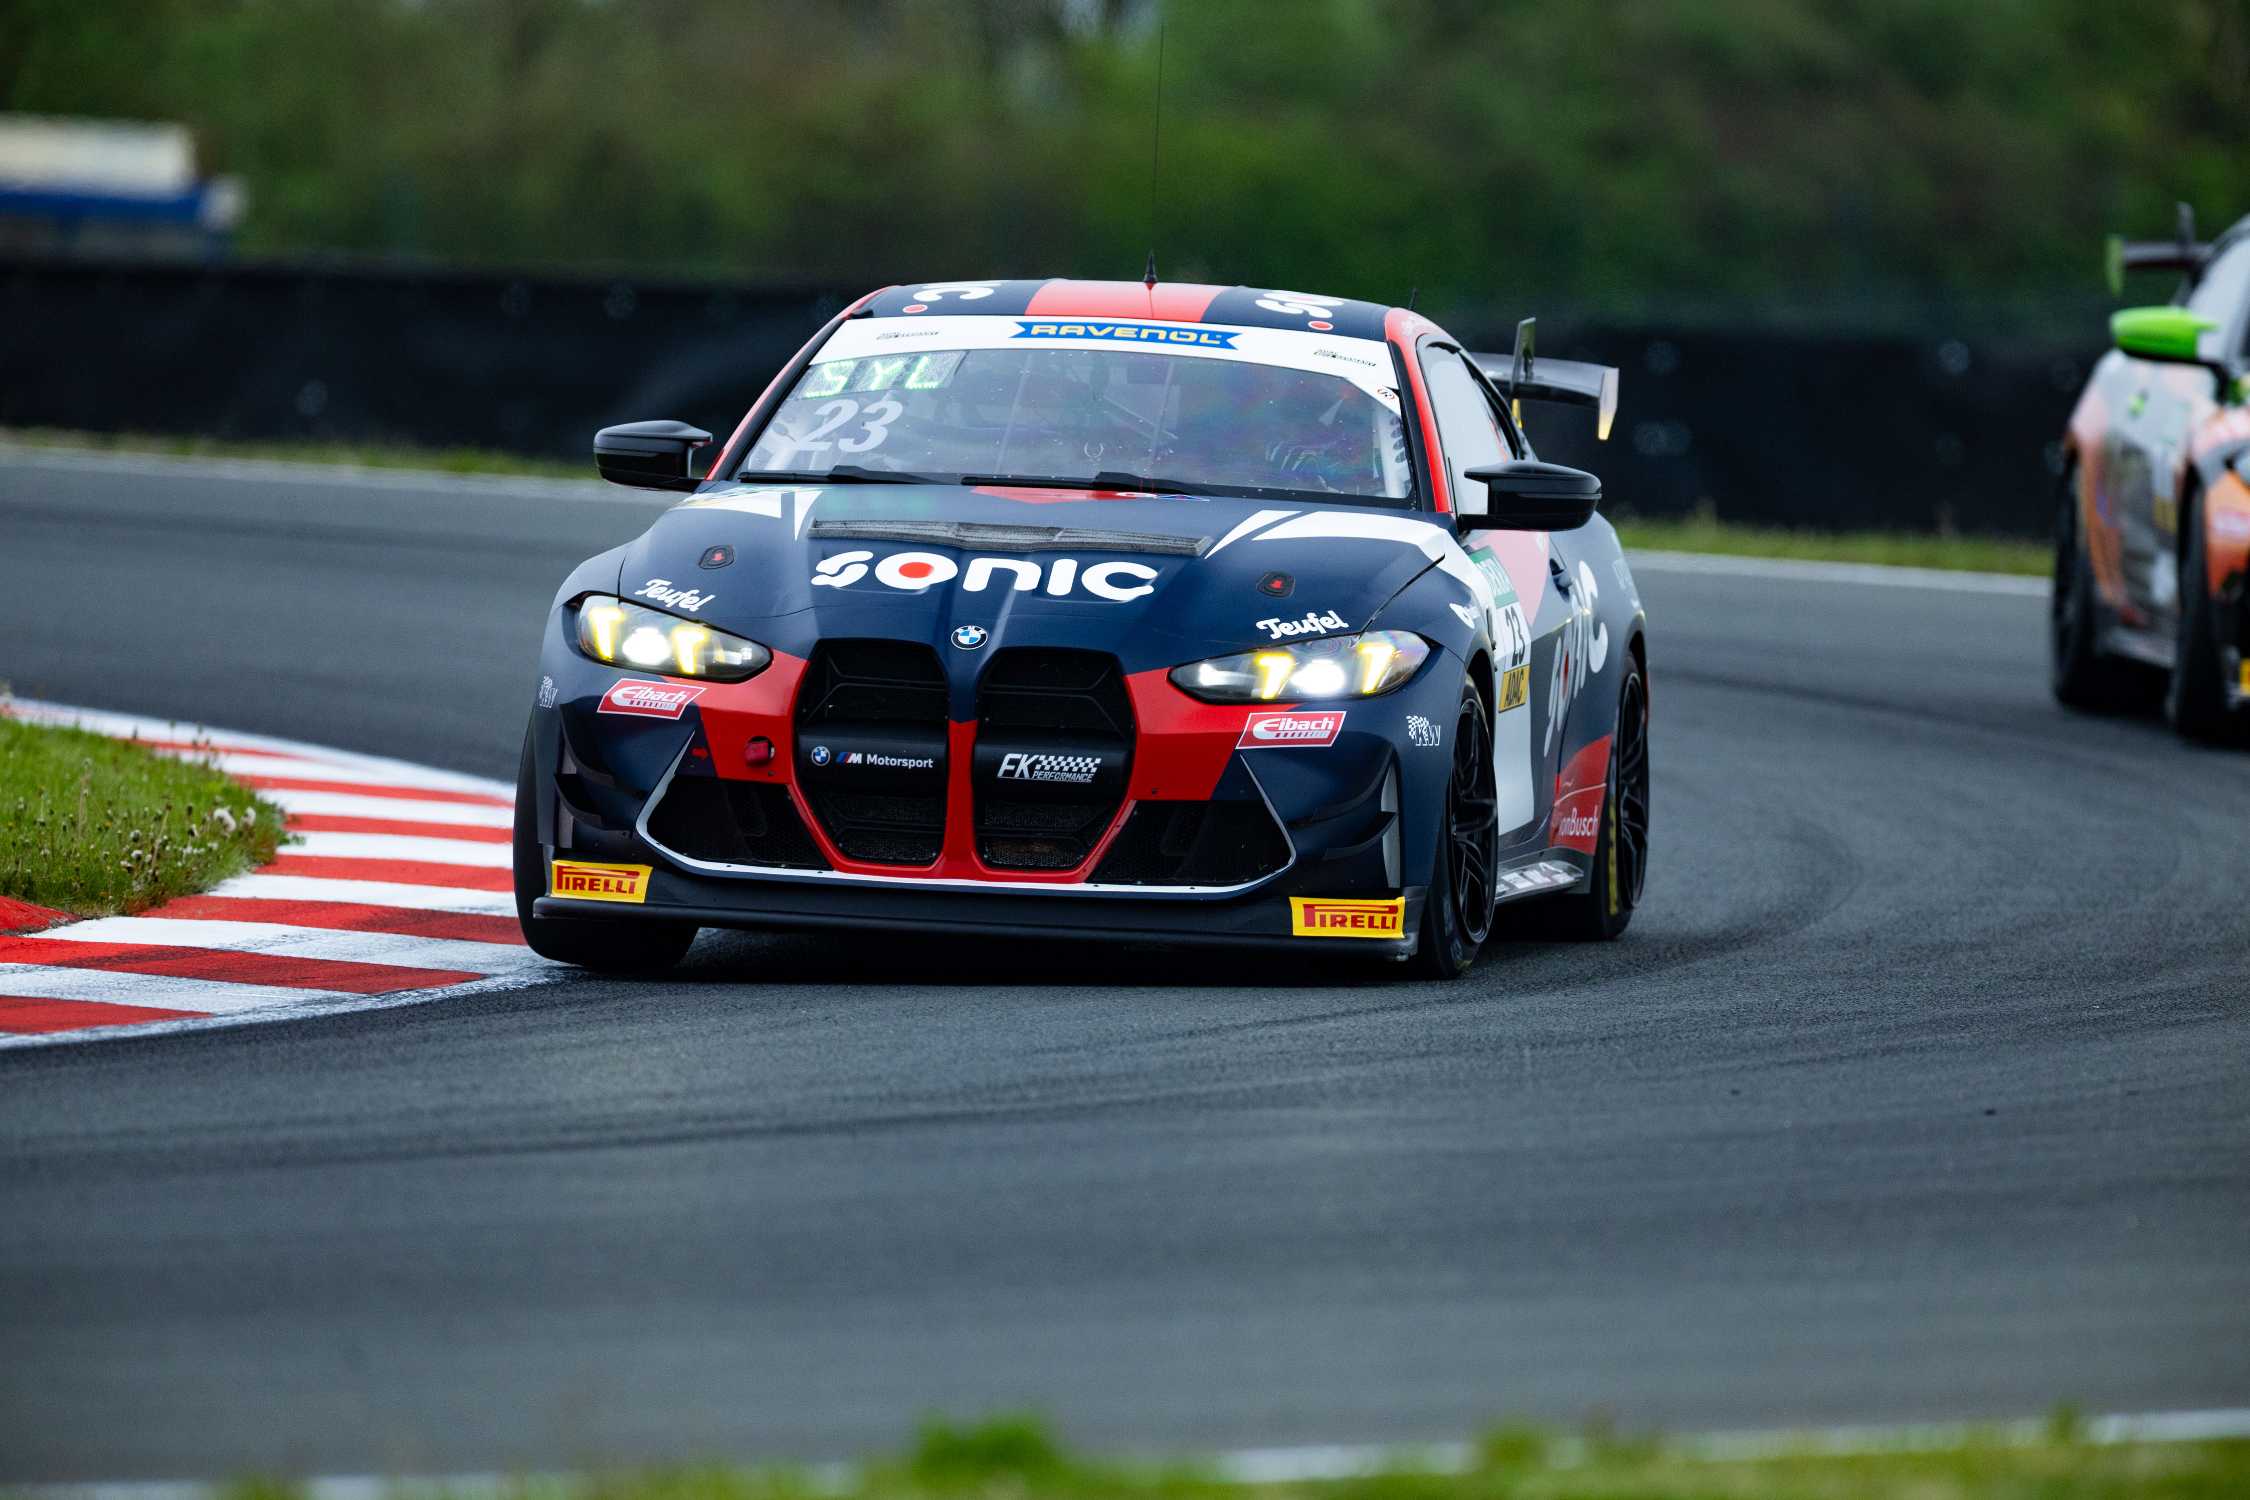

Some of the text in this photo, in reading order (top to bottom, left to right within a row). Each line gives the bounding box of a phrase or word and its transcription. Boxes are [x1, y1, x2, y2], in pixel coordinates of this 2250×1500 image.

[1030, 324, 1221, 345] RAVENOL
[804, 355, 939, 398] SYL
[797, 399, 904, 453] 23
[634, 578, 716, 612] Teufel
[1255, 610, 1350, 640] Teufel
[1504, 605, 1526, 667] 23
[611, 686, 688, 707] Eibach
[1253, 717, 1335, 738] Eibach
[866, 753, 934, 769] Motorsport
[997, 753, 1040, 779] FK
[1032, 770, 1095, 782] PERFORMANCE
[556, 865, 640, 894] PIRELLI
[1303, 903, 1399, 930] PIRELLI
